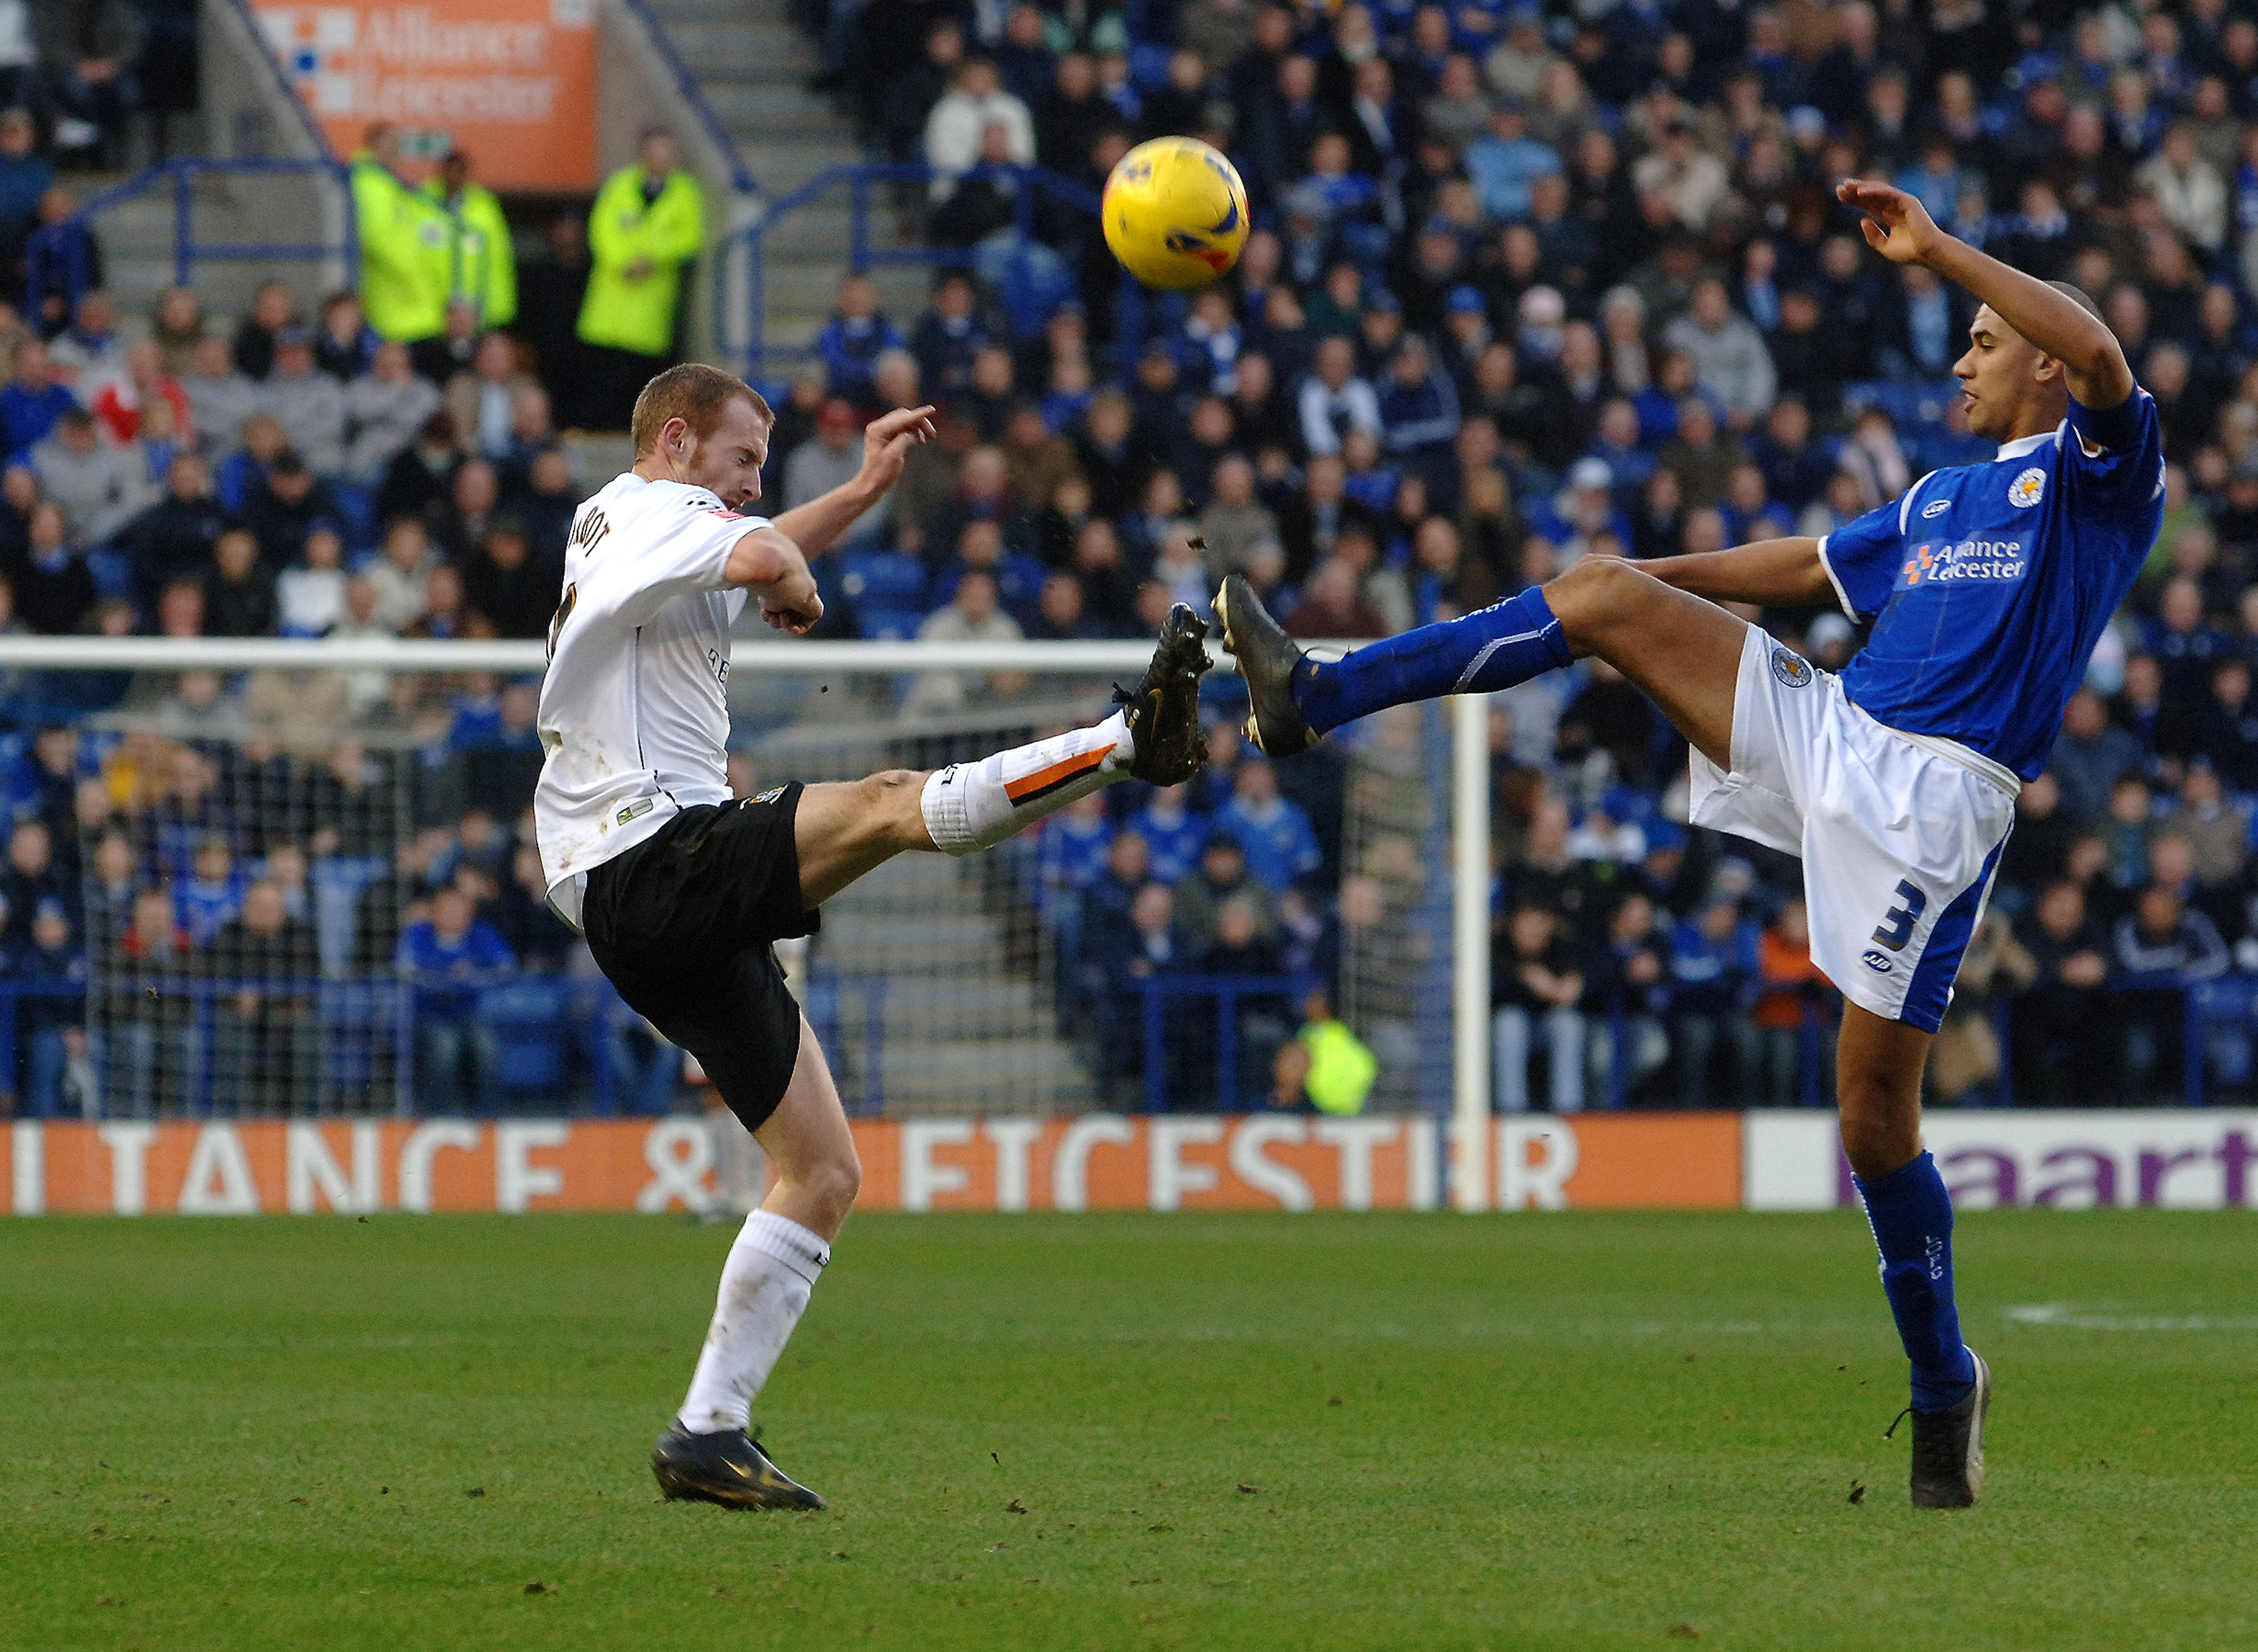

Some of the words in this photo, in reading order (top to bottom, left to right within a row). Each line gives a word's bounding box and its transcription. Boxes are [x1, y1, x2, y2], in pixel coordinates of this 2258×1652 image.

[1871, 878, 1927, 952] 3
[635, 1117, 717, 1215] &
[900, 1114, 1580, 1213] EICESTR
